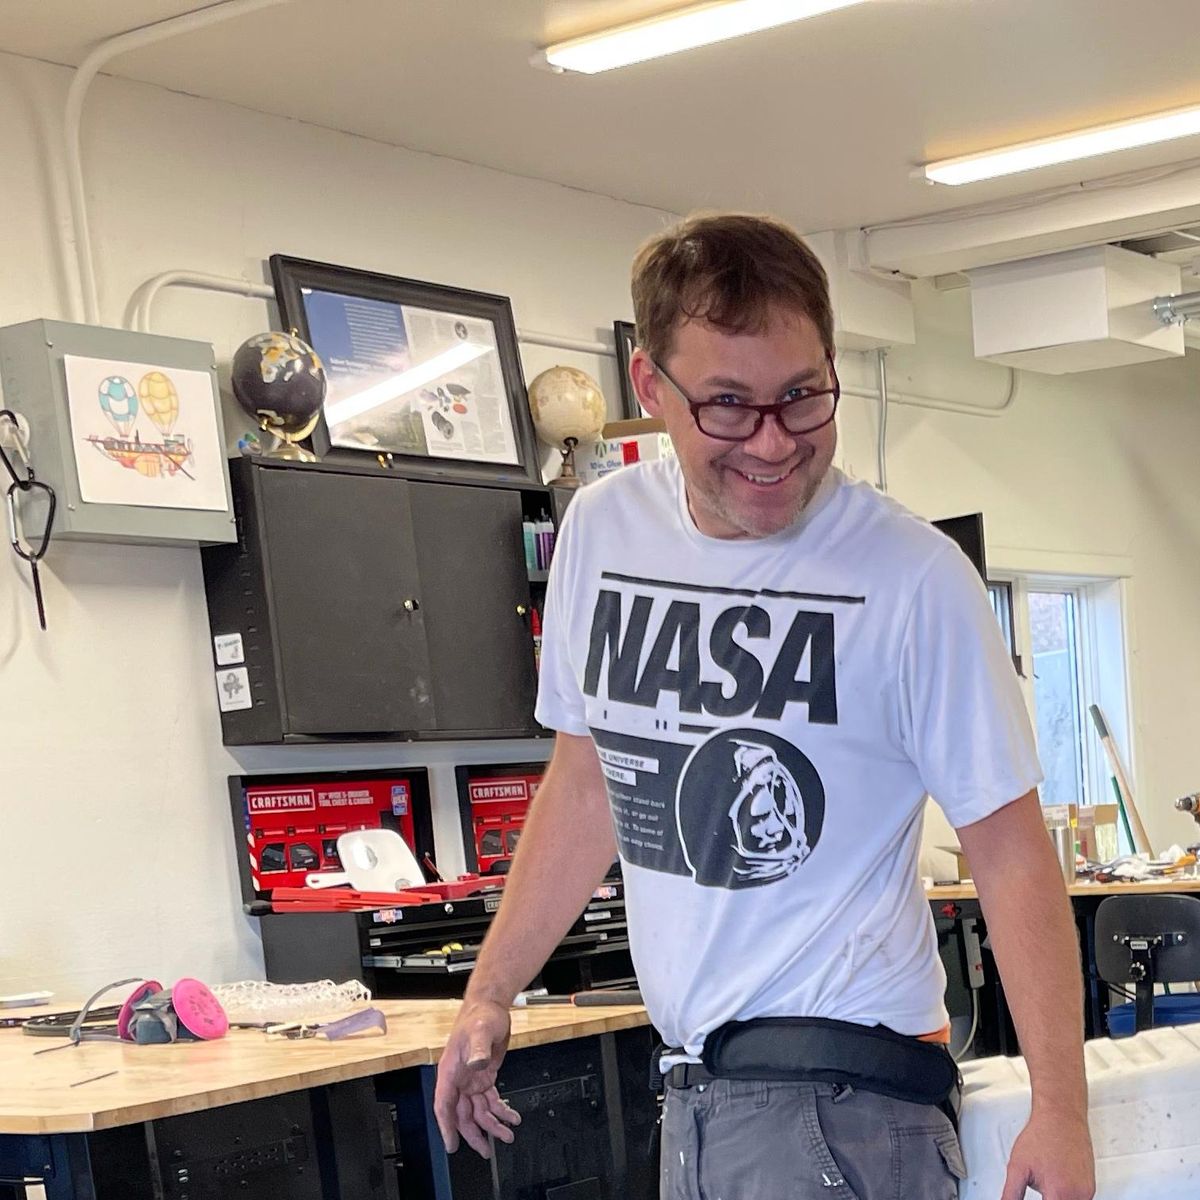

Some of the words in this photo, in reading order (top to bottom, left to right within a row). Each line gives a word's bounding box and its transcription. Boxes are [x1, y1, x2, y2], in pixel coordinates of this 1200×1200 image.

[584, 590, 838, 725] NASA
[608, 755, 645, 768] UNIVERSE
[473, 786, 523, 798] CRAFTSMAN
[251, 795, 311, 809] CRAFTSMAN
